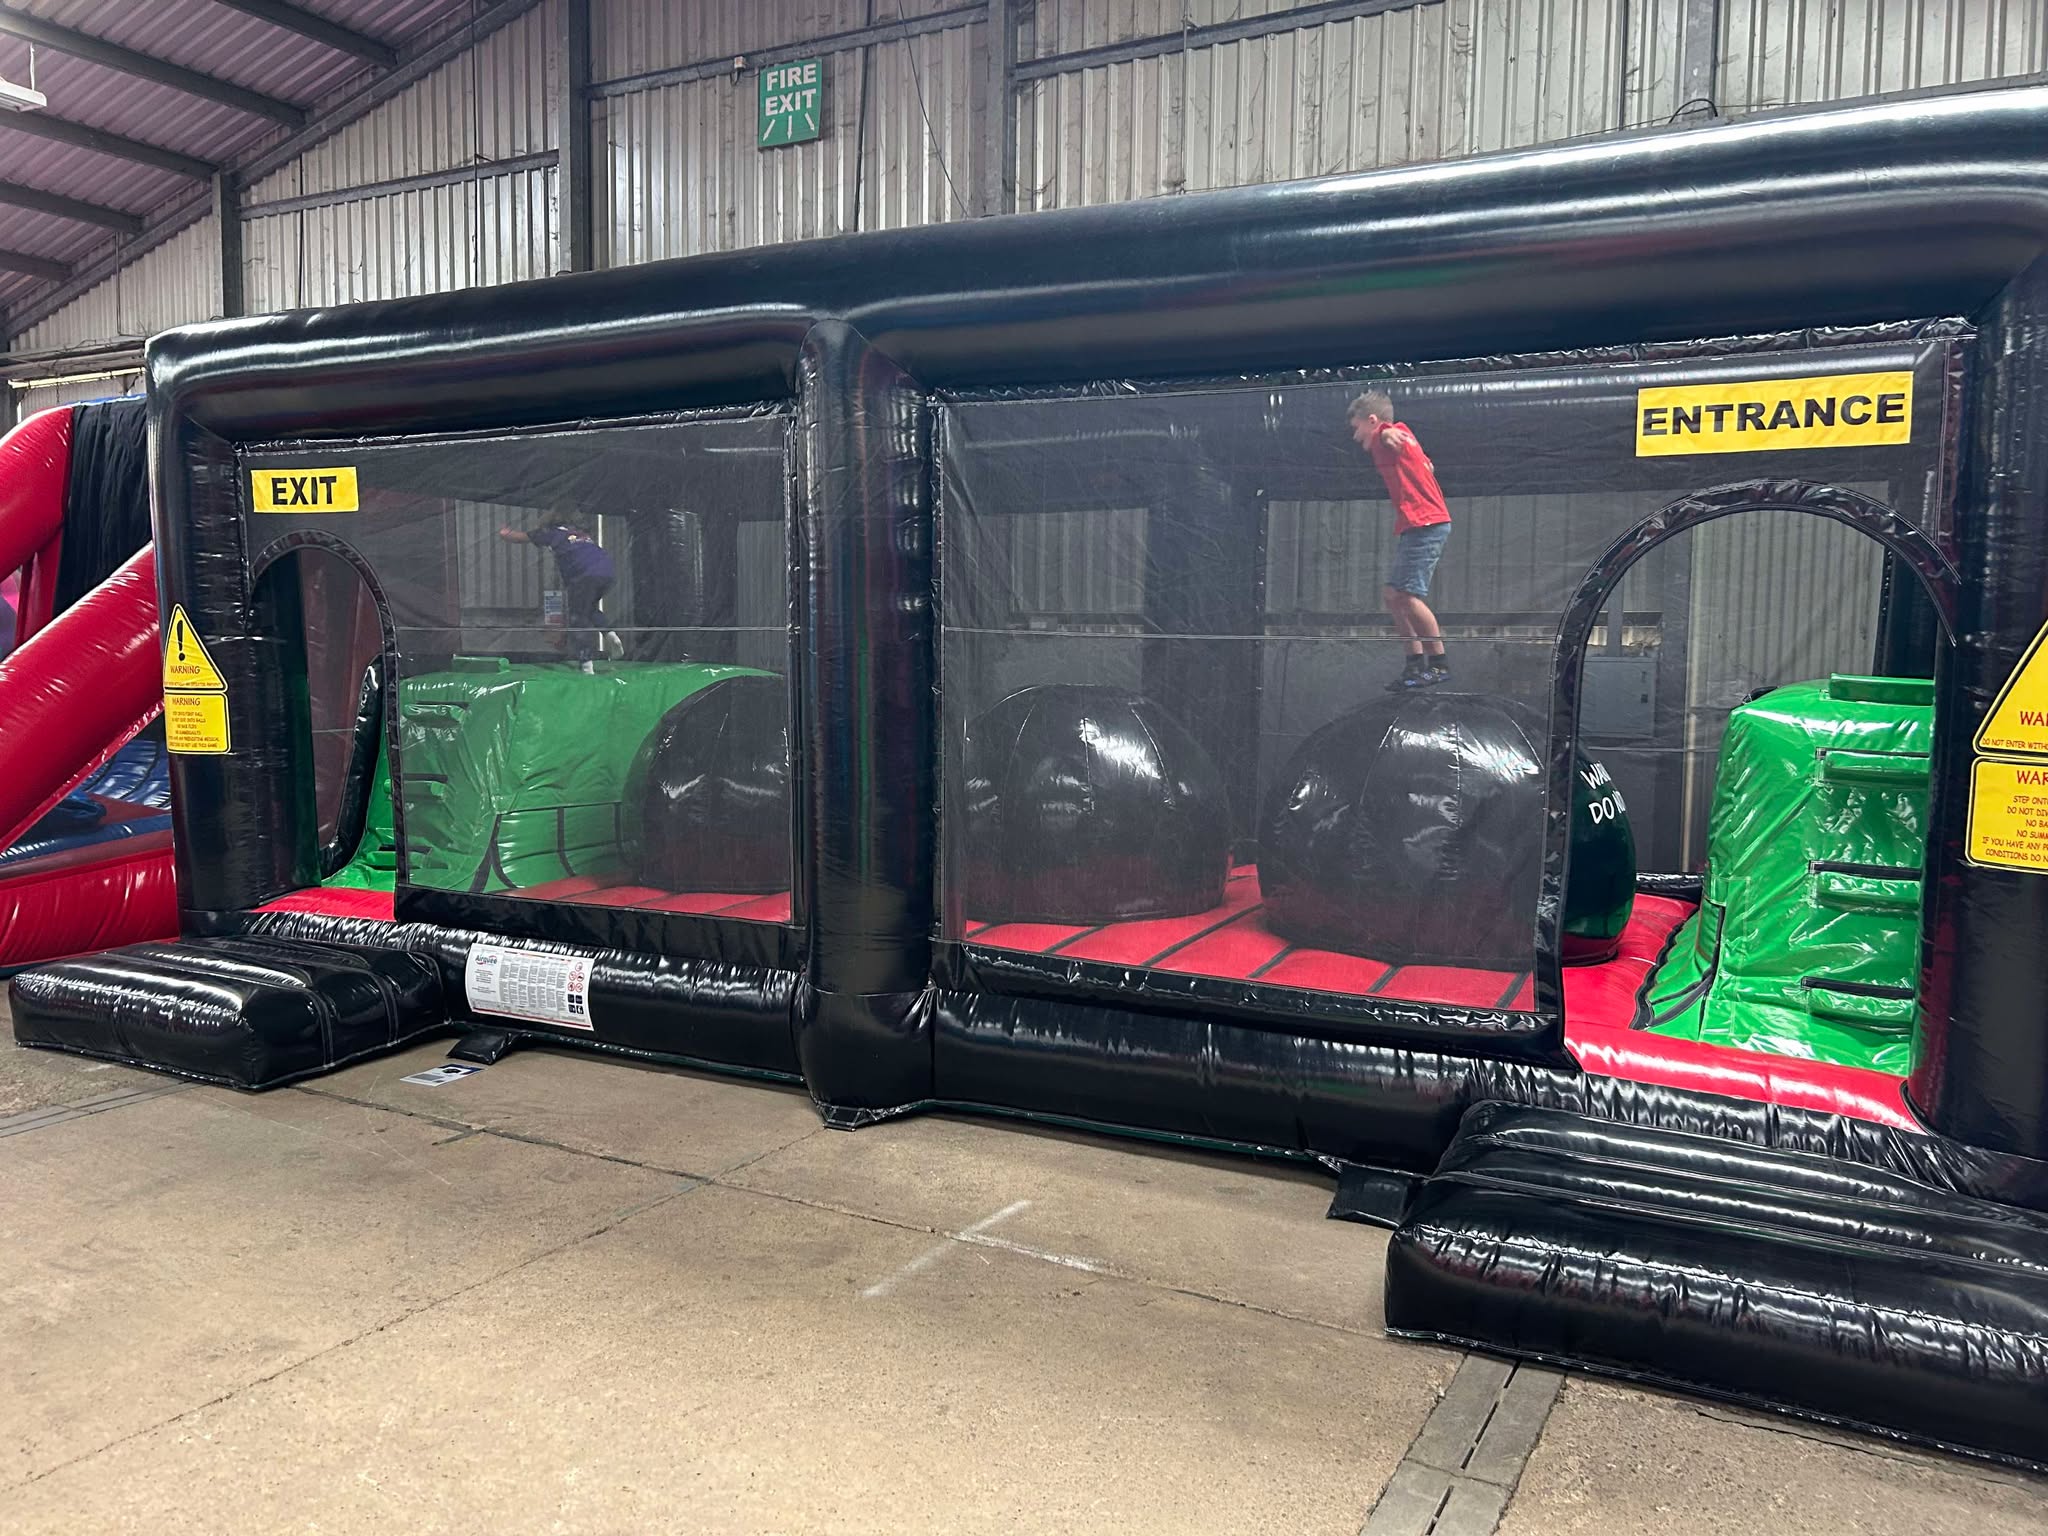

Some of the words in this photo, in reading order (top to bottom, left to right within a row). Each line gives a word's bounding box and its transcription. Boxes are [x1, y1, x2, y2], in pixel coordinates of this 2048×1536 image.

[767, 63, 817, 91] FIRE
[765, 88, 817, 116] EXIT
[1642, 393, 1905, 436] ENTRANCE
[271, 475, 337, 505] EXIT
[170, 665, 200, 674] WARNING
[171, 697, 200, 706] WARNING
[1992, 739, 2004, 747] NOT
[2006, 740, 2026, 749] ENTER
[2013, 795, 2030, 804] STEP
[1589, 796, 1615, 825] DO
[2007, 806, 2017, 815] DO
[2019, 807, 2034, 816] NOT
[2026, 819, 2037, 828] NO
[2016, 829, 2028, 838] NO
[1982, 836, 1989, 844] IF
[1991, 837, 2004, 847] YOU
[2006, 839, 2024, 849] HAVE
[2026, 842, 2041, 850] ANY
[1986, 848, 2028, 861] CONDITIONS
[2030, 853, 2041, 862] DO
